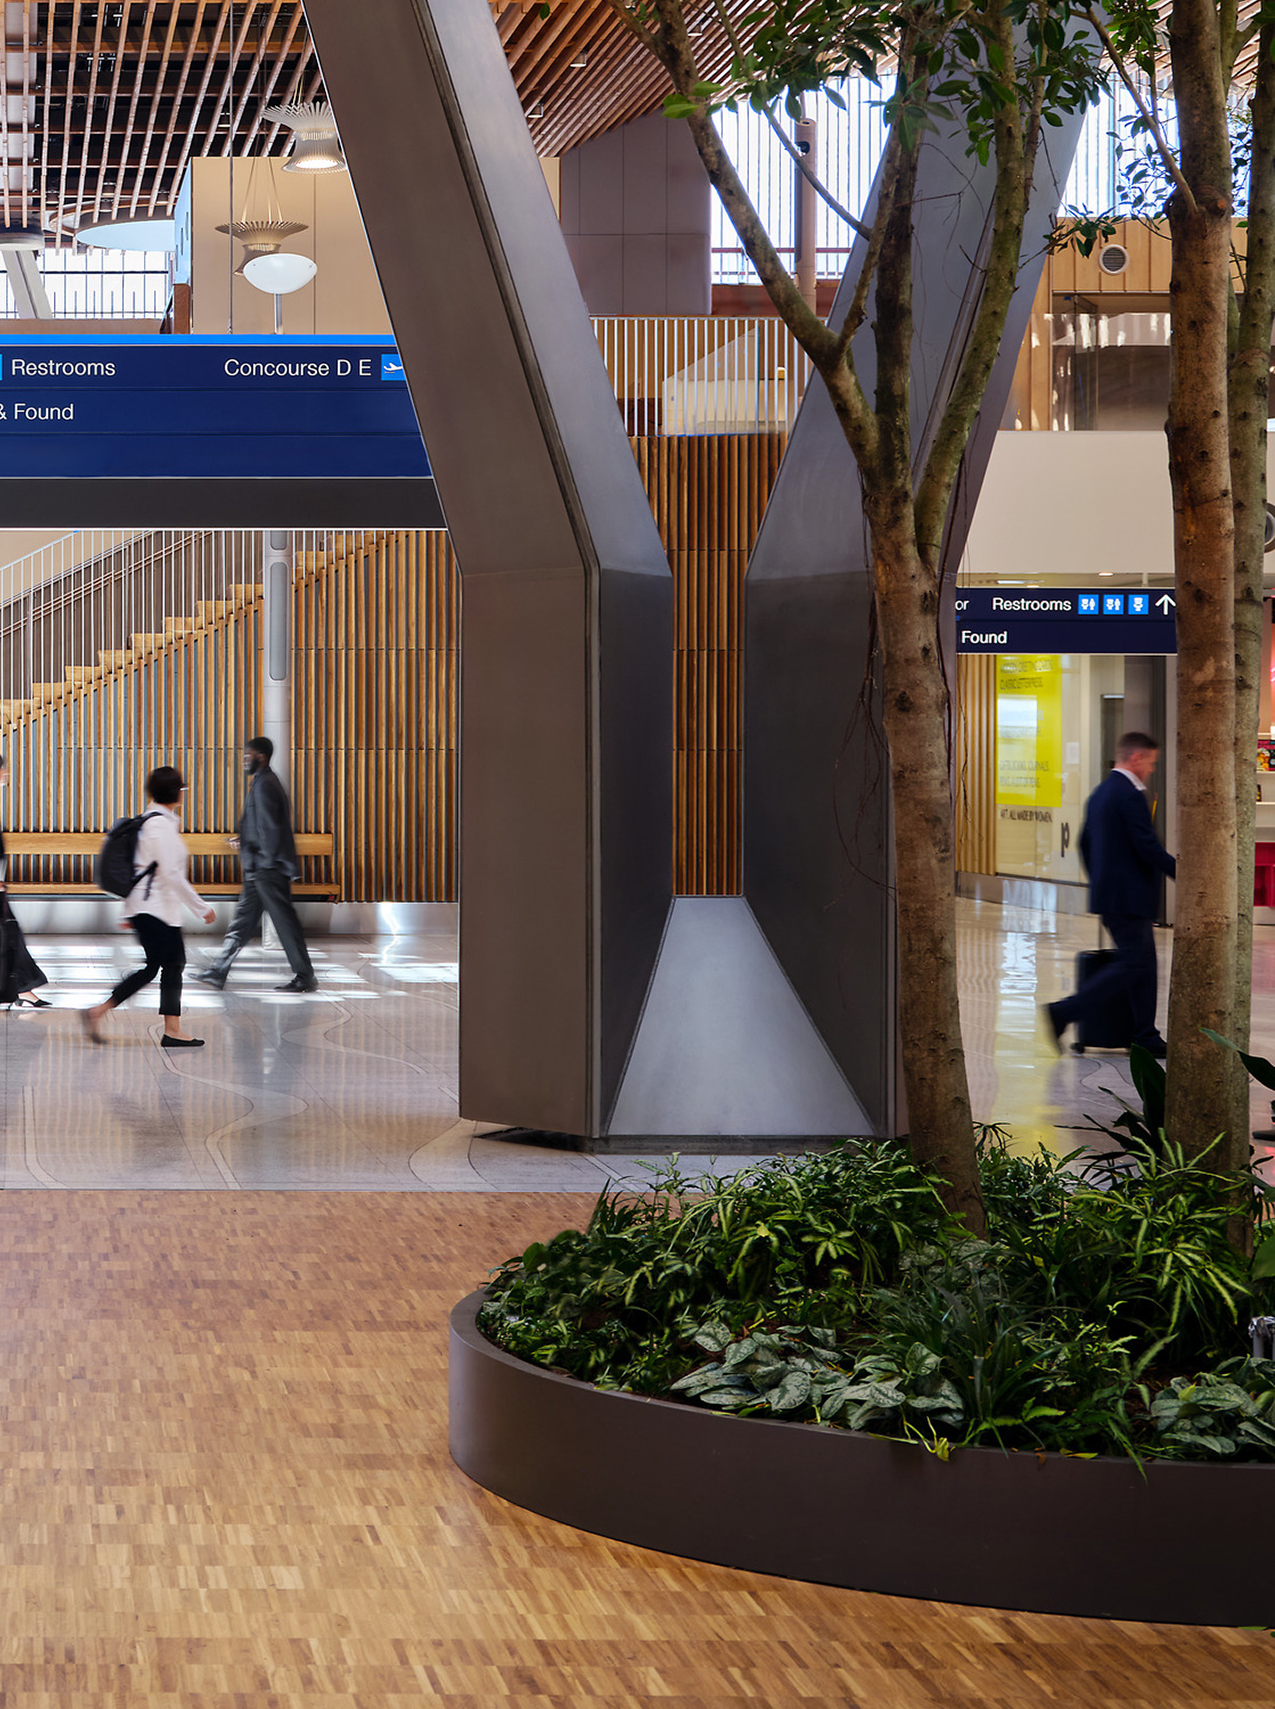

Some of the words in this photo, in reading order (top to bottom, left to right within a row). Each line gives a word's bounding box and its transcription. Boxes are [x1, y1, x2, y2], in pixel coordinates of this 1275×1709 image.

[11, 358, 116, 377] Restrooms
[224, 359, 330, 377] Concourse
[337, 359, 352, 376] D
[359, 359, 372, 376] E
[14, 403, 74, 421] Found
[992, 597, 1072, 611] Restrooms
[961, 630, 1008, 644] Found
